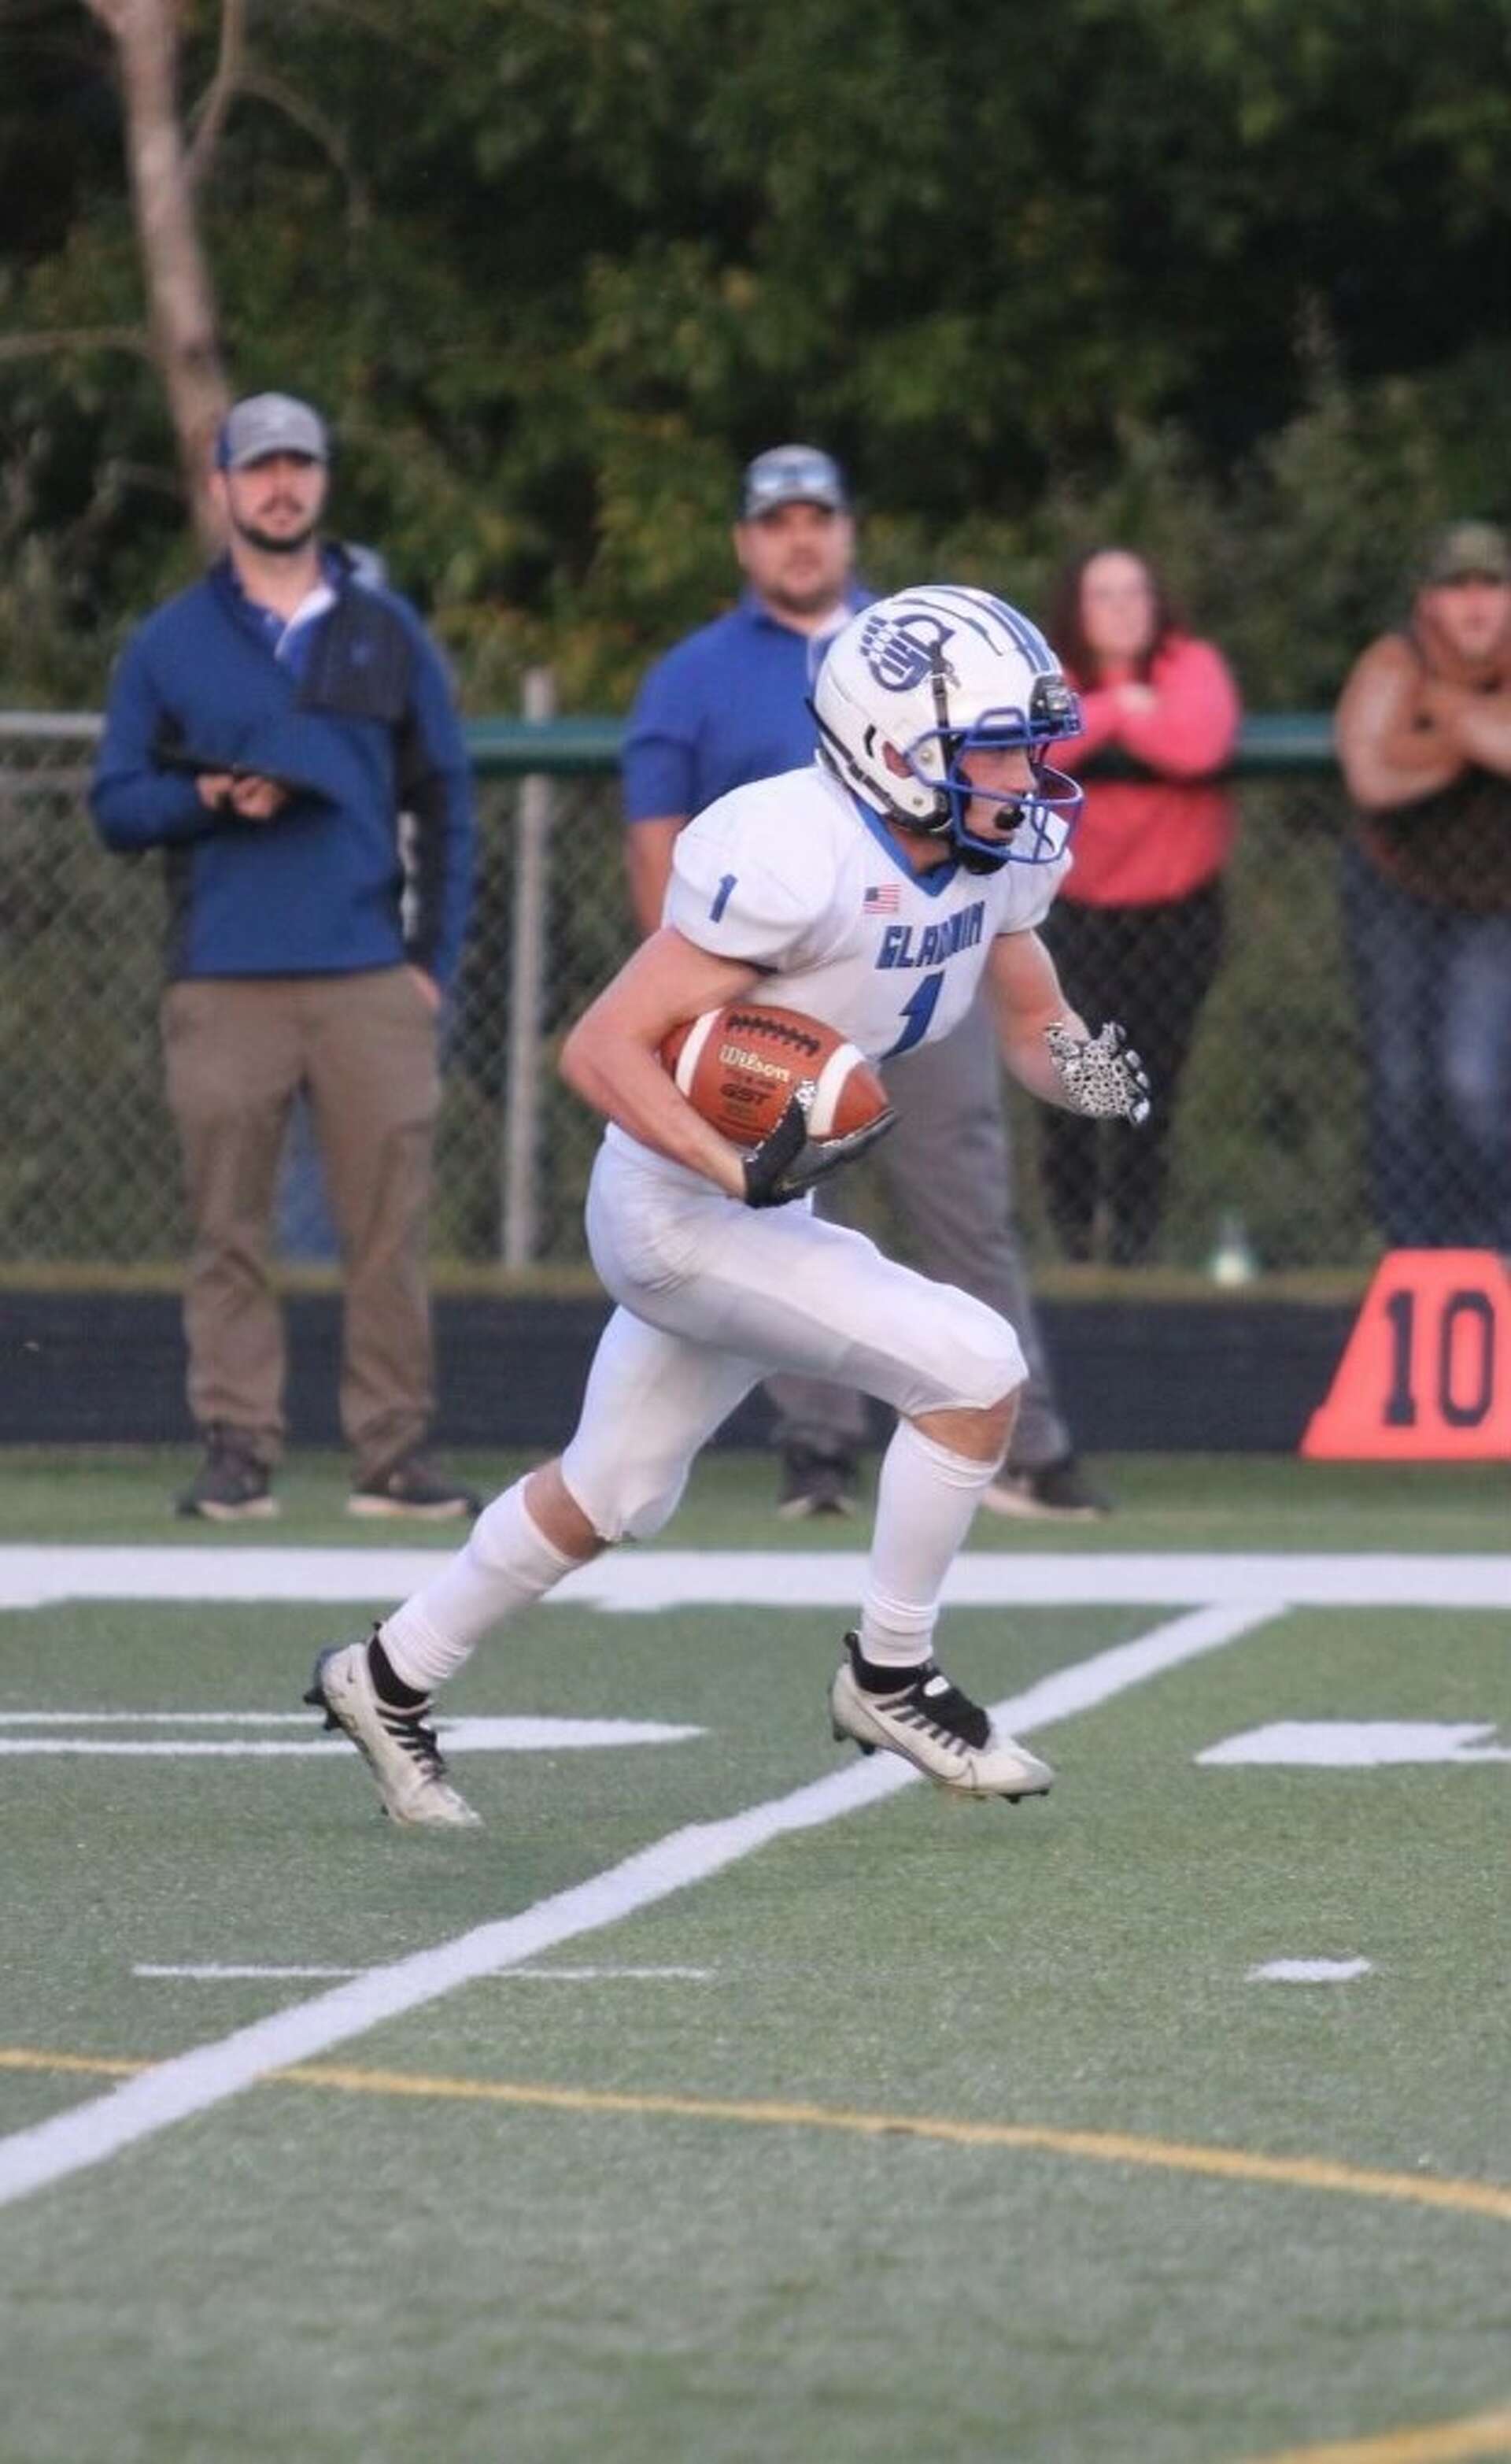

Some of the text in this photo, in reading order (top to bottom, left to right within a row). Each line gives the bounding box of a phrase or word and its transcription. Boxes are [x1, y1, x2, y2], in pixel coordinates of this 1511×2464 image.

[710, 874, 738, 923] 1
[878, 969, 945, 1060] 1
[719, 1044, 789, 1083] Wilson
[1383, 1289, 1494, 1428] 10
